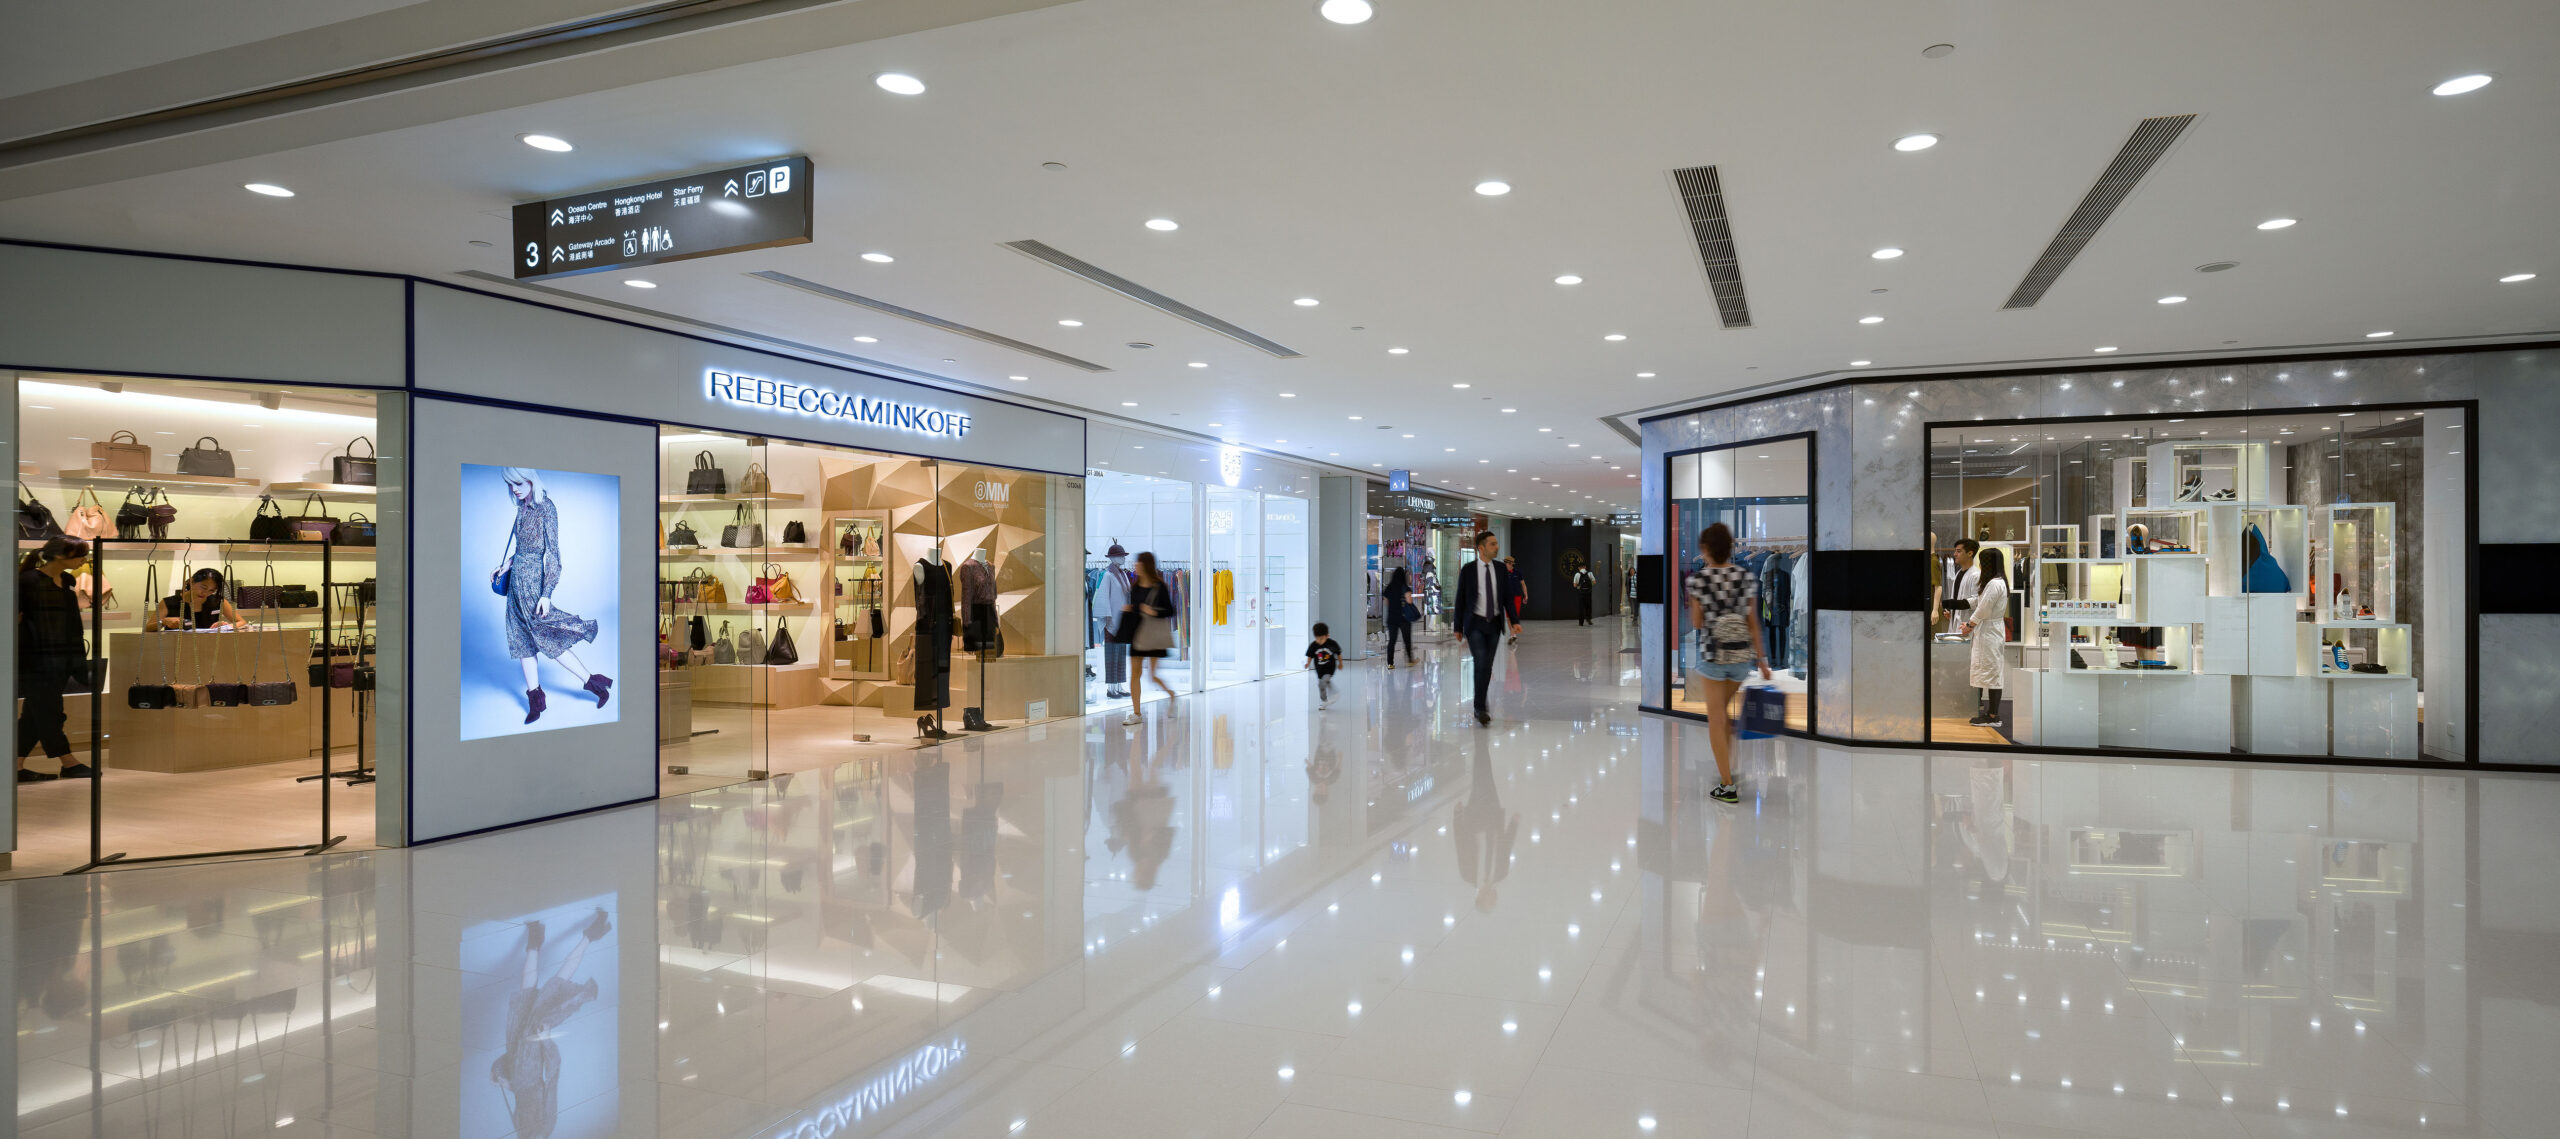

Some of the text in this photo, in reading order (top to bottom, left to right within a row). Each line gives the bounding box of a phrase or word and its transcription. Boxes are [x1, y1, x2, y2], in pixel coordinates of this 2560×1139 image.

[673, 185, 704, 197] Star Ferry
[615, 191, 663, 206] Hongkong Hotel
[568, 202, 608, 214] Ocean Centre
[615, 205, 641, 217] 香港酒店
[568, 213, 594, 225] 海洋中心
[568, 237, 616, 251] Gateway Arcade
[526, 241, 539, 267] 3
[1407, 495, 1436, 511] LEONARD
